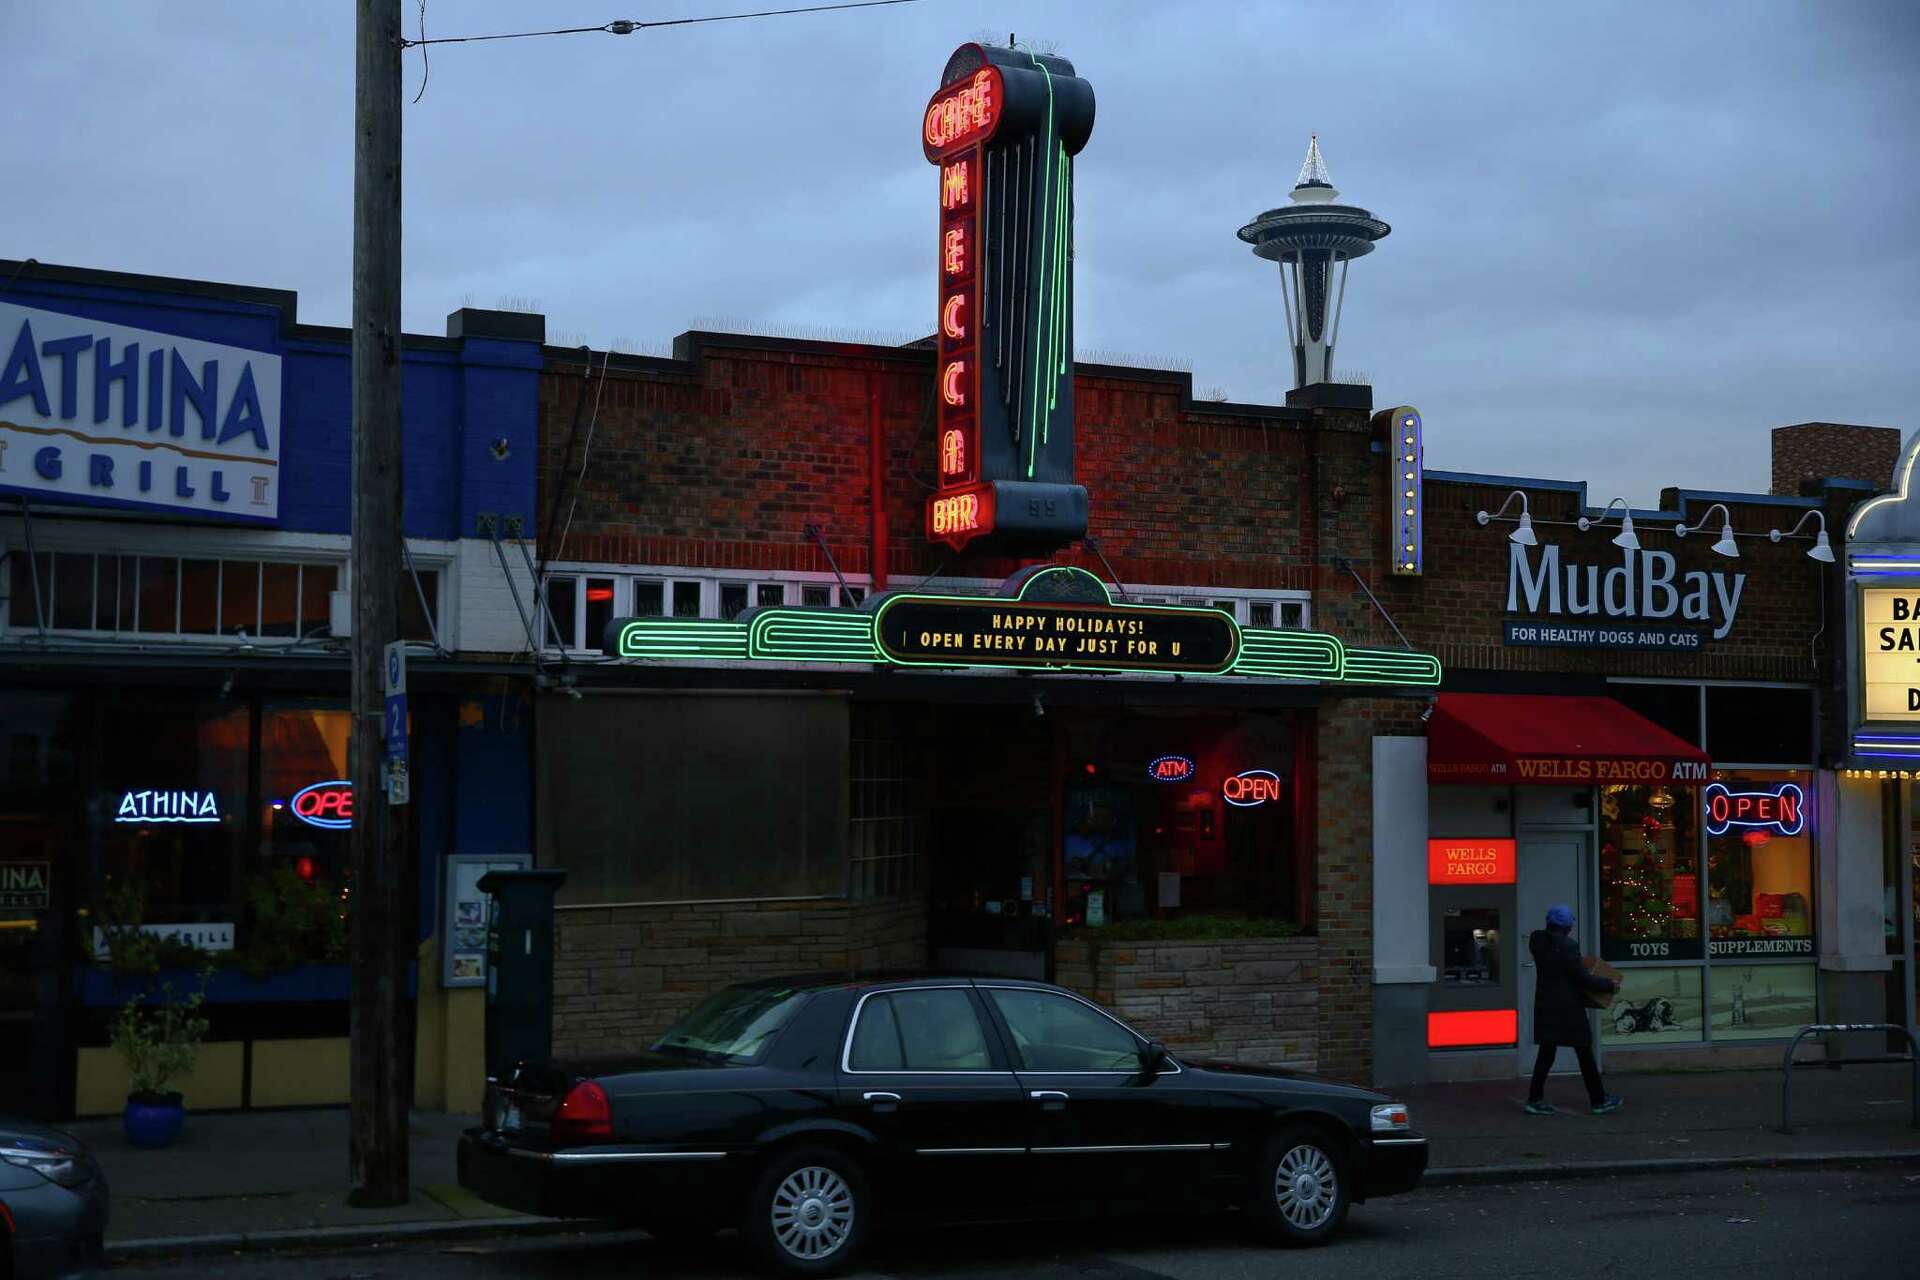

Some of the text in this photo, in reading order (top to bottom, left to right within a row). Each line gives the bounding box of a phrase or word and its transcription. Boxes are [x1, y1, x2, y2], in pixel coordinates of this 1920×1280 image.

[943, 160, 968, 475] MECCA
[0, 318, 269, 450] ATHINA
[35, 446, 230, 502] GRILL
[933, 494, 979, 534] BAR
[993, 614, 1144, 635] HAPPY HOLIDAYS!
[1511, 626, 1698, 647] FOR HEALTHY DOGS AND CATS
[920, 631, 1181, 657] OPEN EVERY DAY JUST FOR U
[1880, 627, 1920, 651] SA
[391, 703, 400, 737] 2
[1157, 761, 1187, 777] ATM
[1491, 763, 1508, 774] ATM
[1516, 759, 1707, 781] WELLS FARGO ATM
[1223, 776, 1280, 801] OPEN
[118, 791, 218, 816] ATHINA
[1712, 794, 1797, 822] OPEN
[1446, 847, 1497, 861] WELLS
[1447, 862, 1497, 876] FARGO
[1630, 938, 1813, 957] TOYS SUPPLEMENTS
